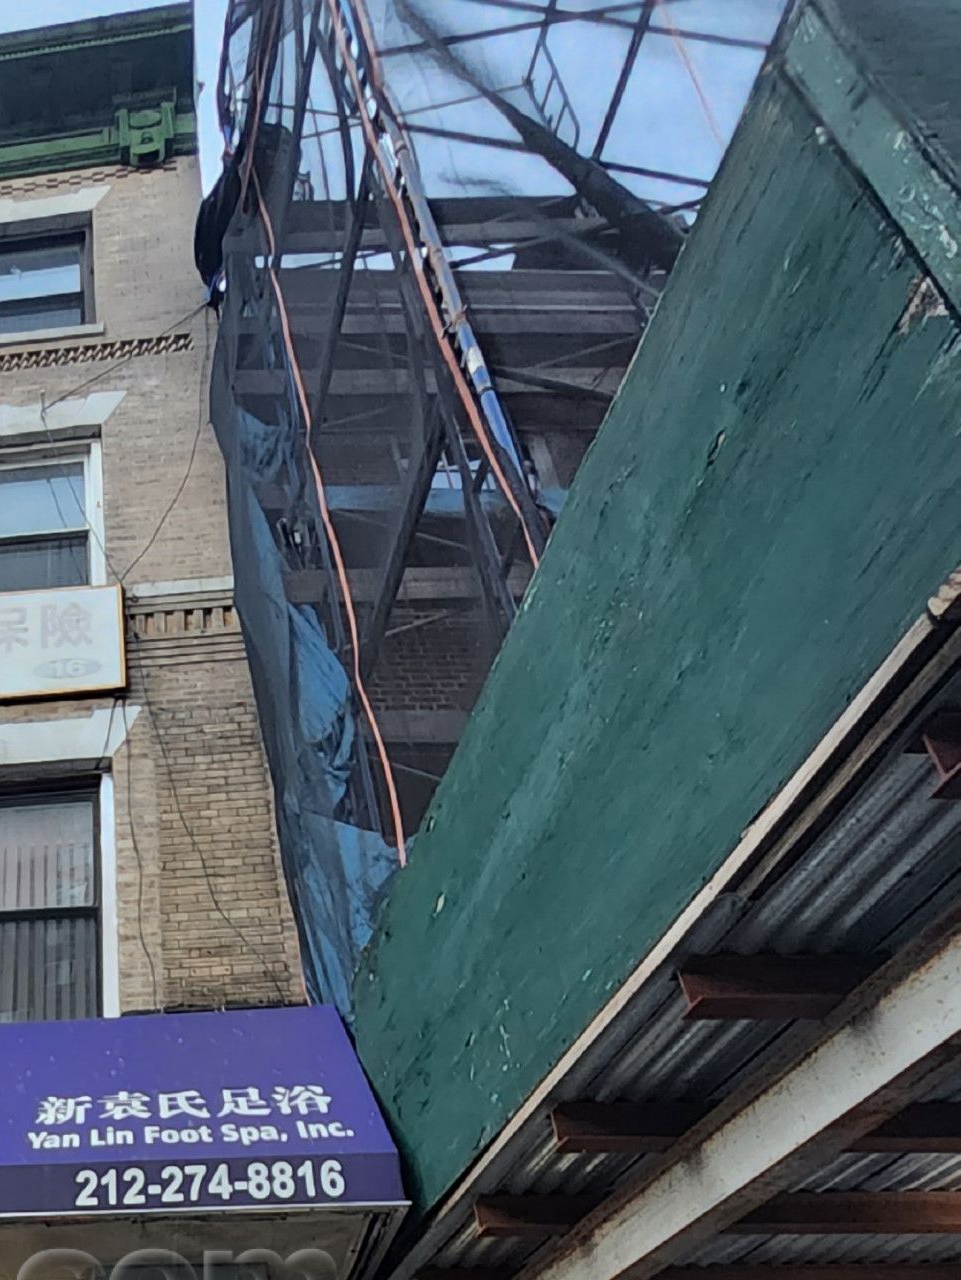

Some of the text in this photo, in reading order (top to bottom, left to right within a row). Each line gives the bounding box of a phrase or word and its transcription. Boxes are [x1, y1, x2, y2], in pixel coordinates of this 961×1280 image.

[51, 658, 85, 678] 16
[35, 1084, 332, 1126] 新袁氏足浴
[28, 1120, 355, 1149] Yan Lin Foot Spa, Inc.
[75, 1159, 346, 1206] 212-274-8816
